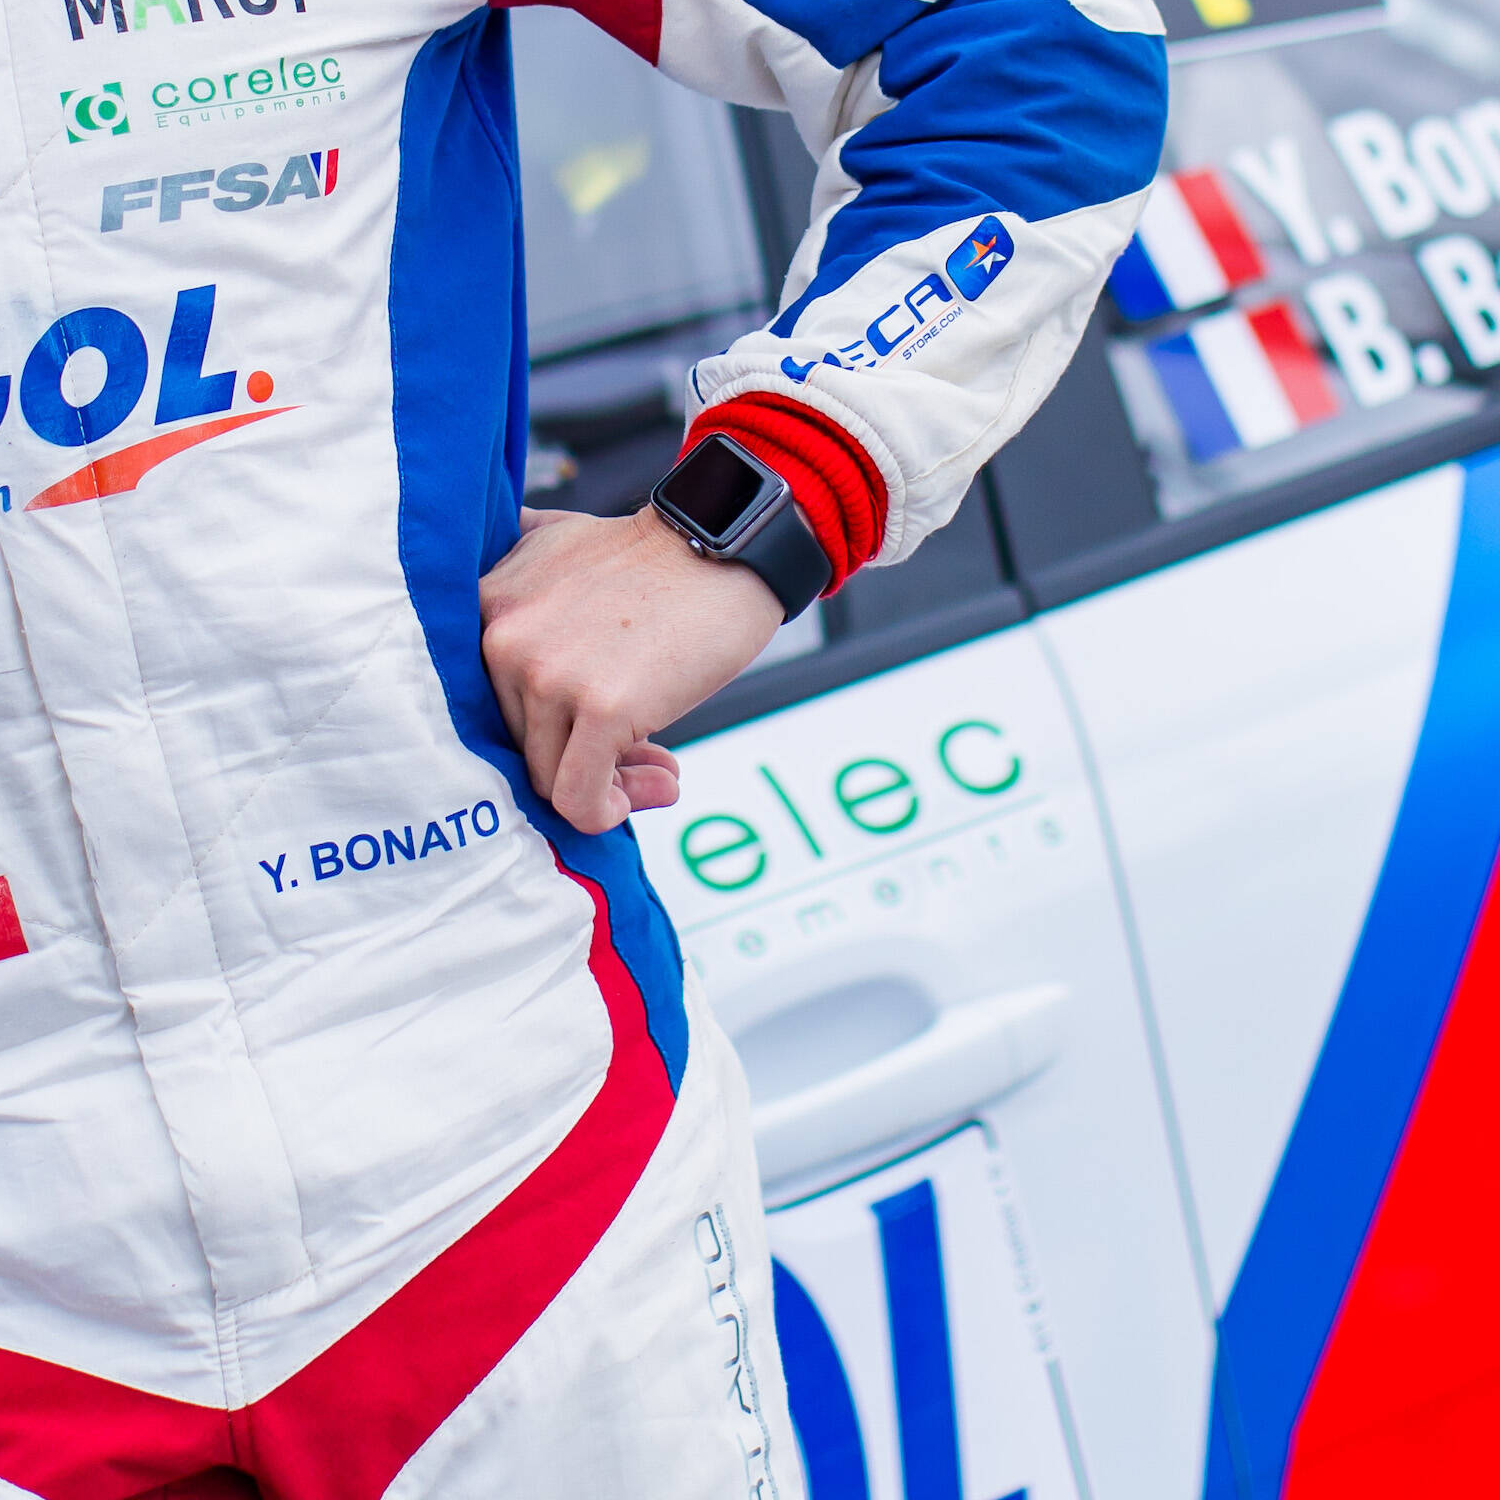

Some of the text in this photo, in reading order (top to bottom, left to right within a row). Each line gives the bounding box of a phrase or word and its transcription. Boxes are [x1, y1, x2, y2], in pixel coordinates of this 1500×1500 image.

[152, 56, 342, 109] corelec
[157, 91, 347, 129] Equipements
[100, 152, 324, 234] FFSA
[1231, 137, 1362, 267] Y.
[902, 306, 965, 361] STORE.COM
[1307, 272, 1454, 410] B.
[258, 799, 502, 895] Y. BONATO
[678, 718, 1021, 891] elec
